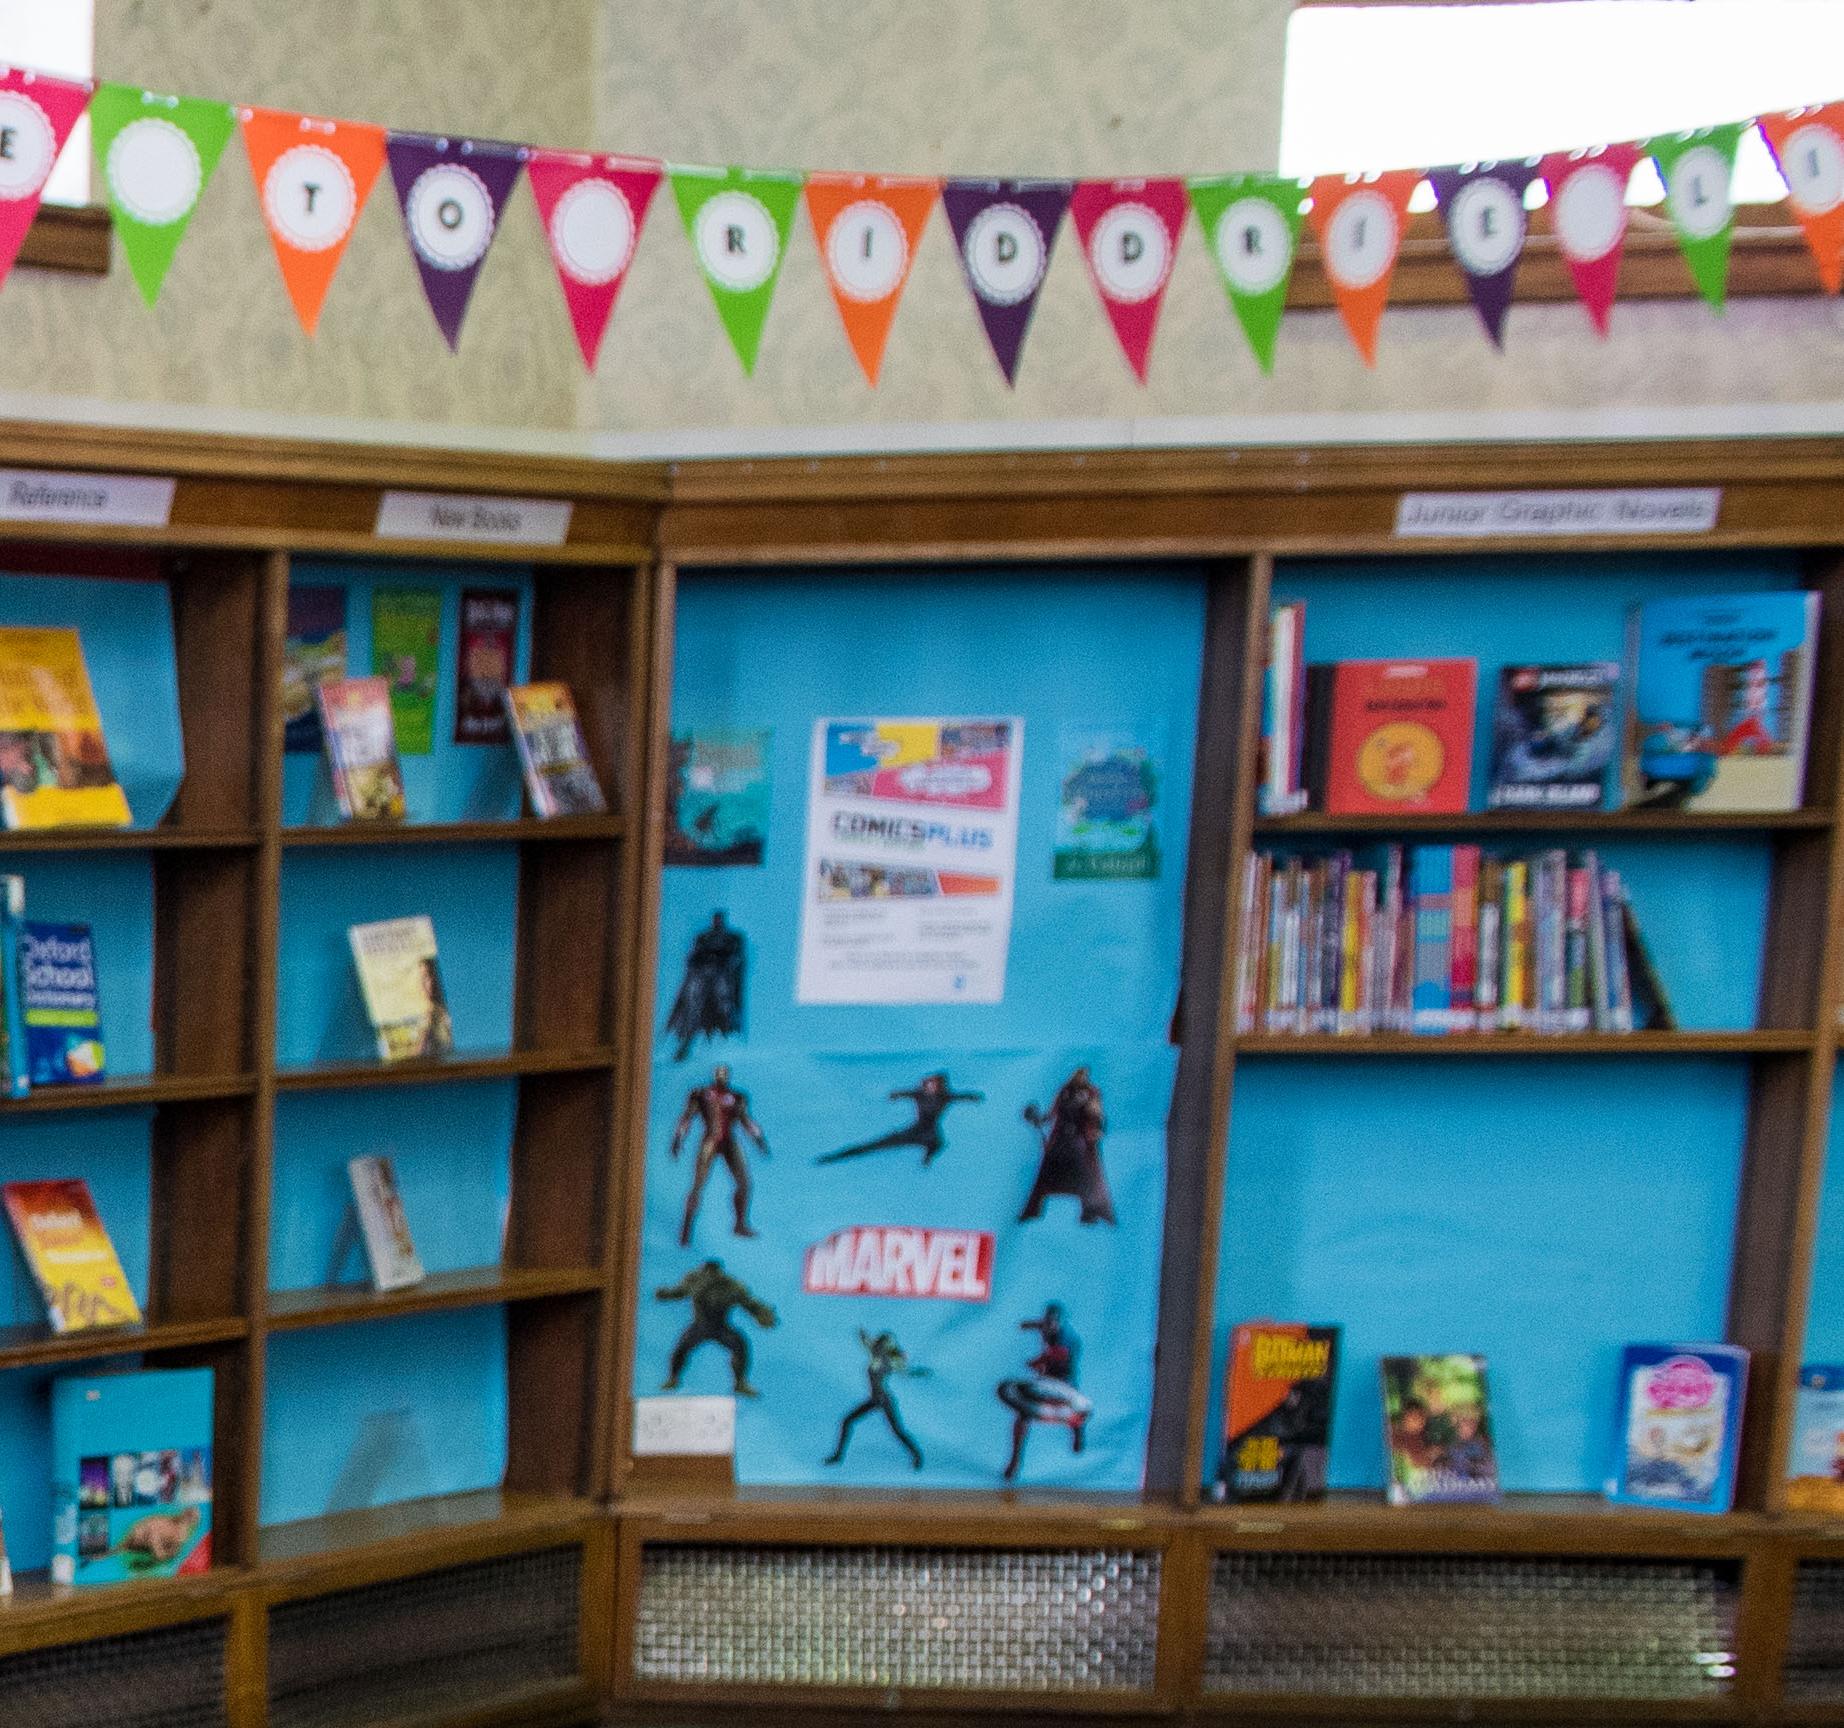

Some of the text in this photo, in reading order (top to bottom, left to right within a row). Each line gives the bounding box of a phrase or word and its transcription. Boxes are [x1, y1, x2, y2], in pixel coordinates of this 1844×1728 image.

[302, 183, 463, 231] TO
[8, 480, 108, 509] Reference
[473, 504, 523, 531] Books
[1407, 499, 1709, 527] Junior Graphic Novels
[809, 1229, 986, 1297] MARVEL
